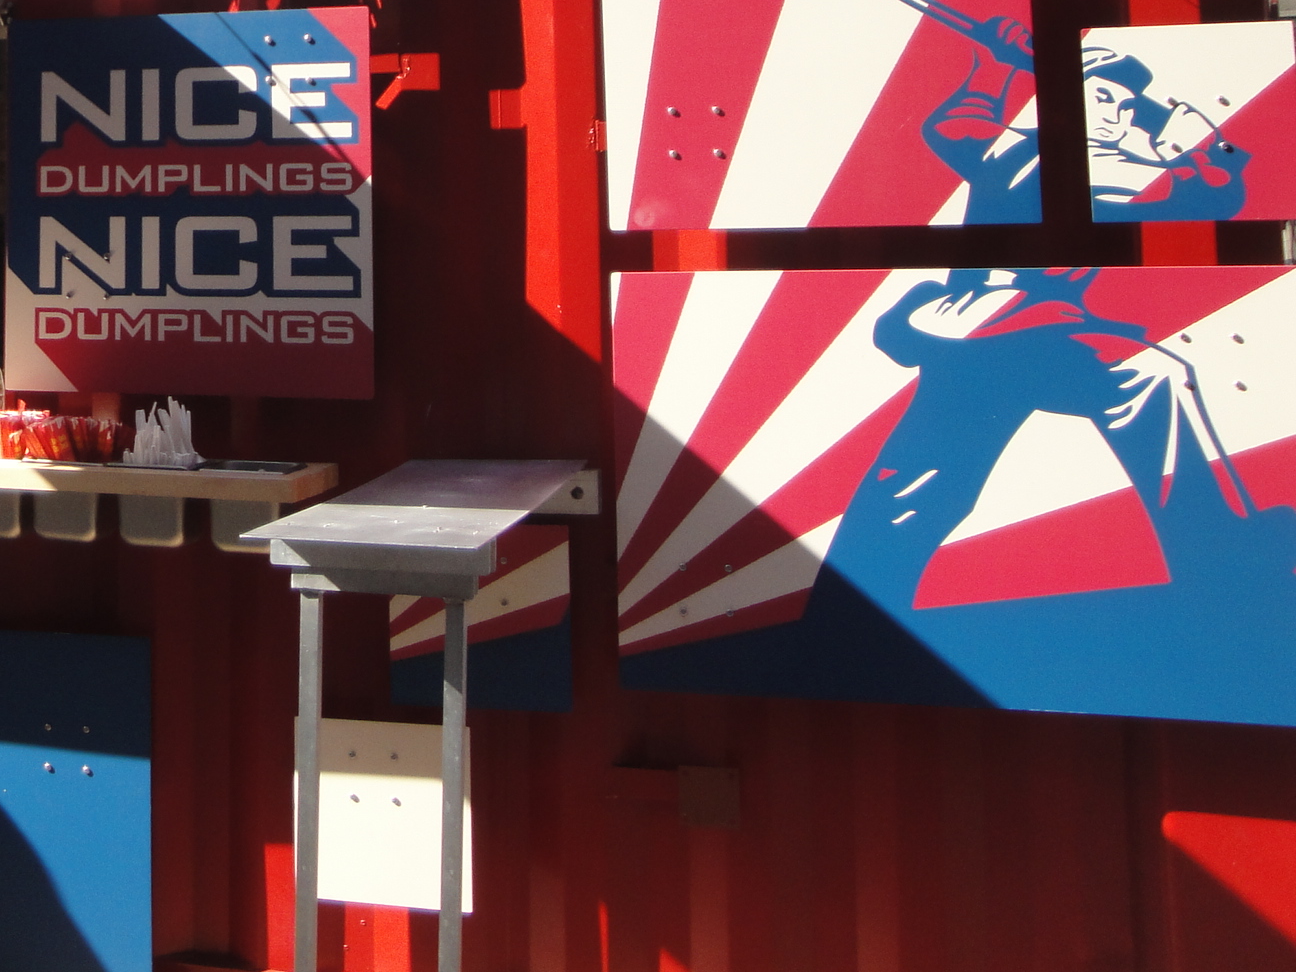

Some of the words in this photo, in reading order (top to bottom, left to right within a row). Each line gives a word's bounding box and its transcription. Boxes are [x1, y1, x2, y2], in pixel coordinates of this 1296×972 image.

[41, 63, 353, 142] NICE
[40, 162, 353, 193] DUMPLINGS
[39, 215, 354, 291] NICE
[38, 311, 355, 344] DUMPLINGS
